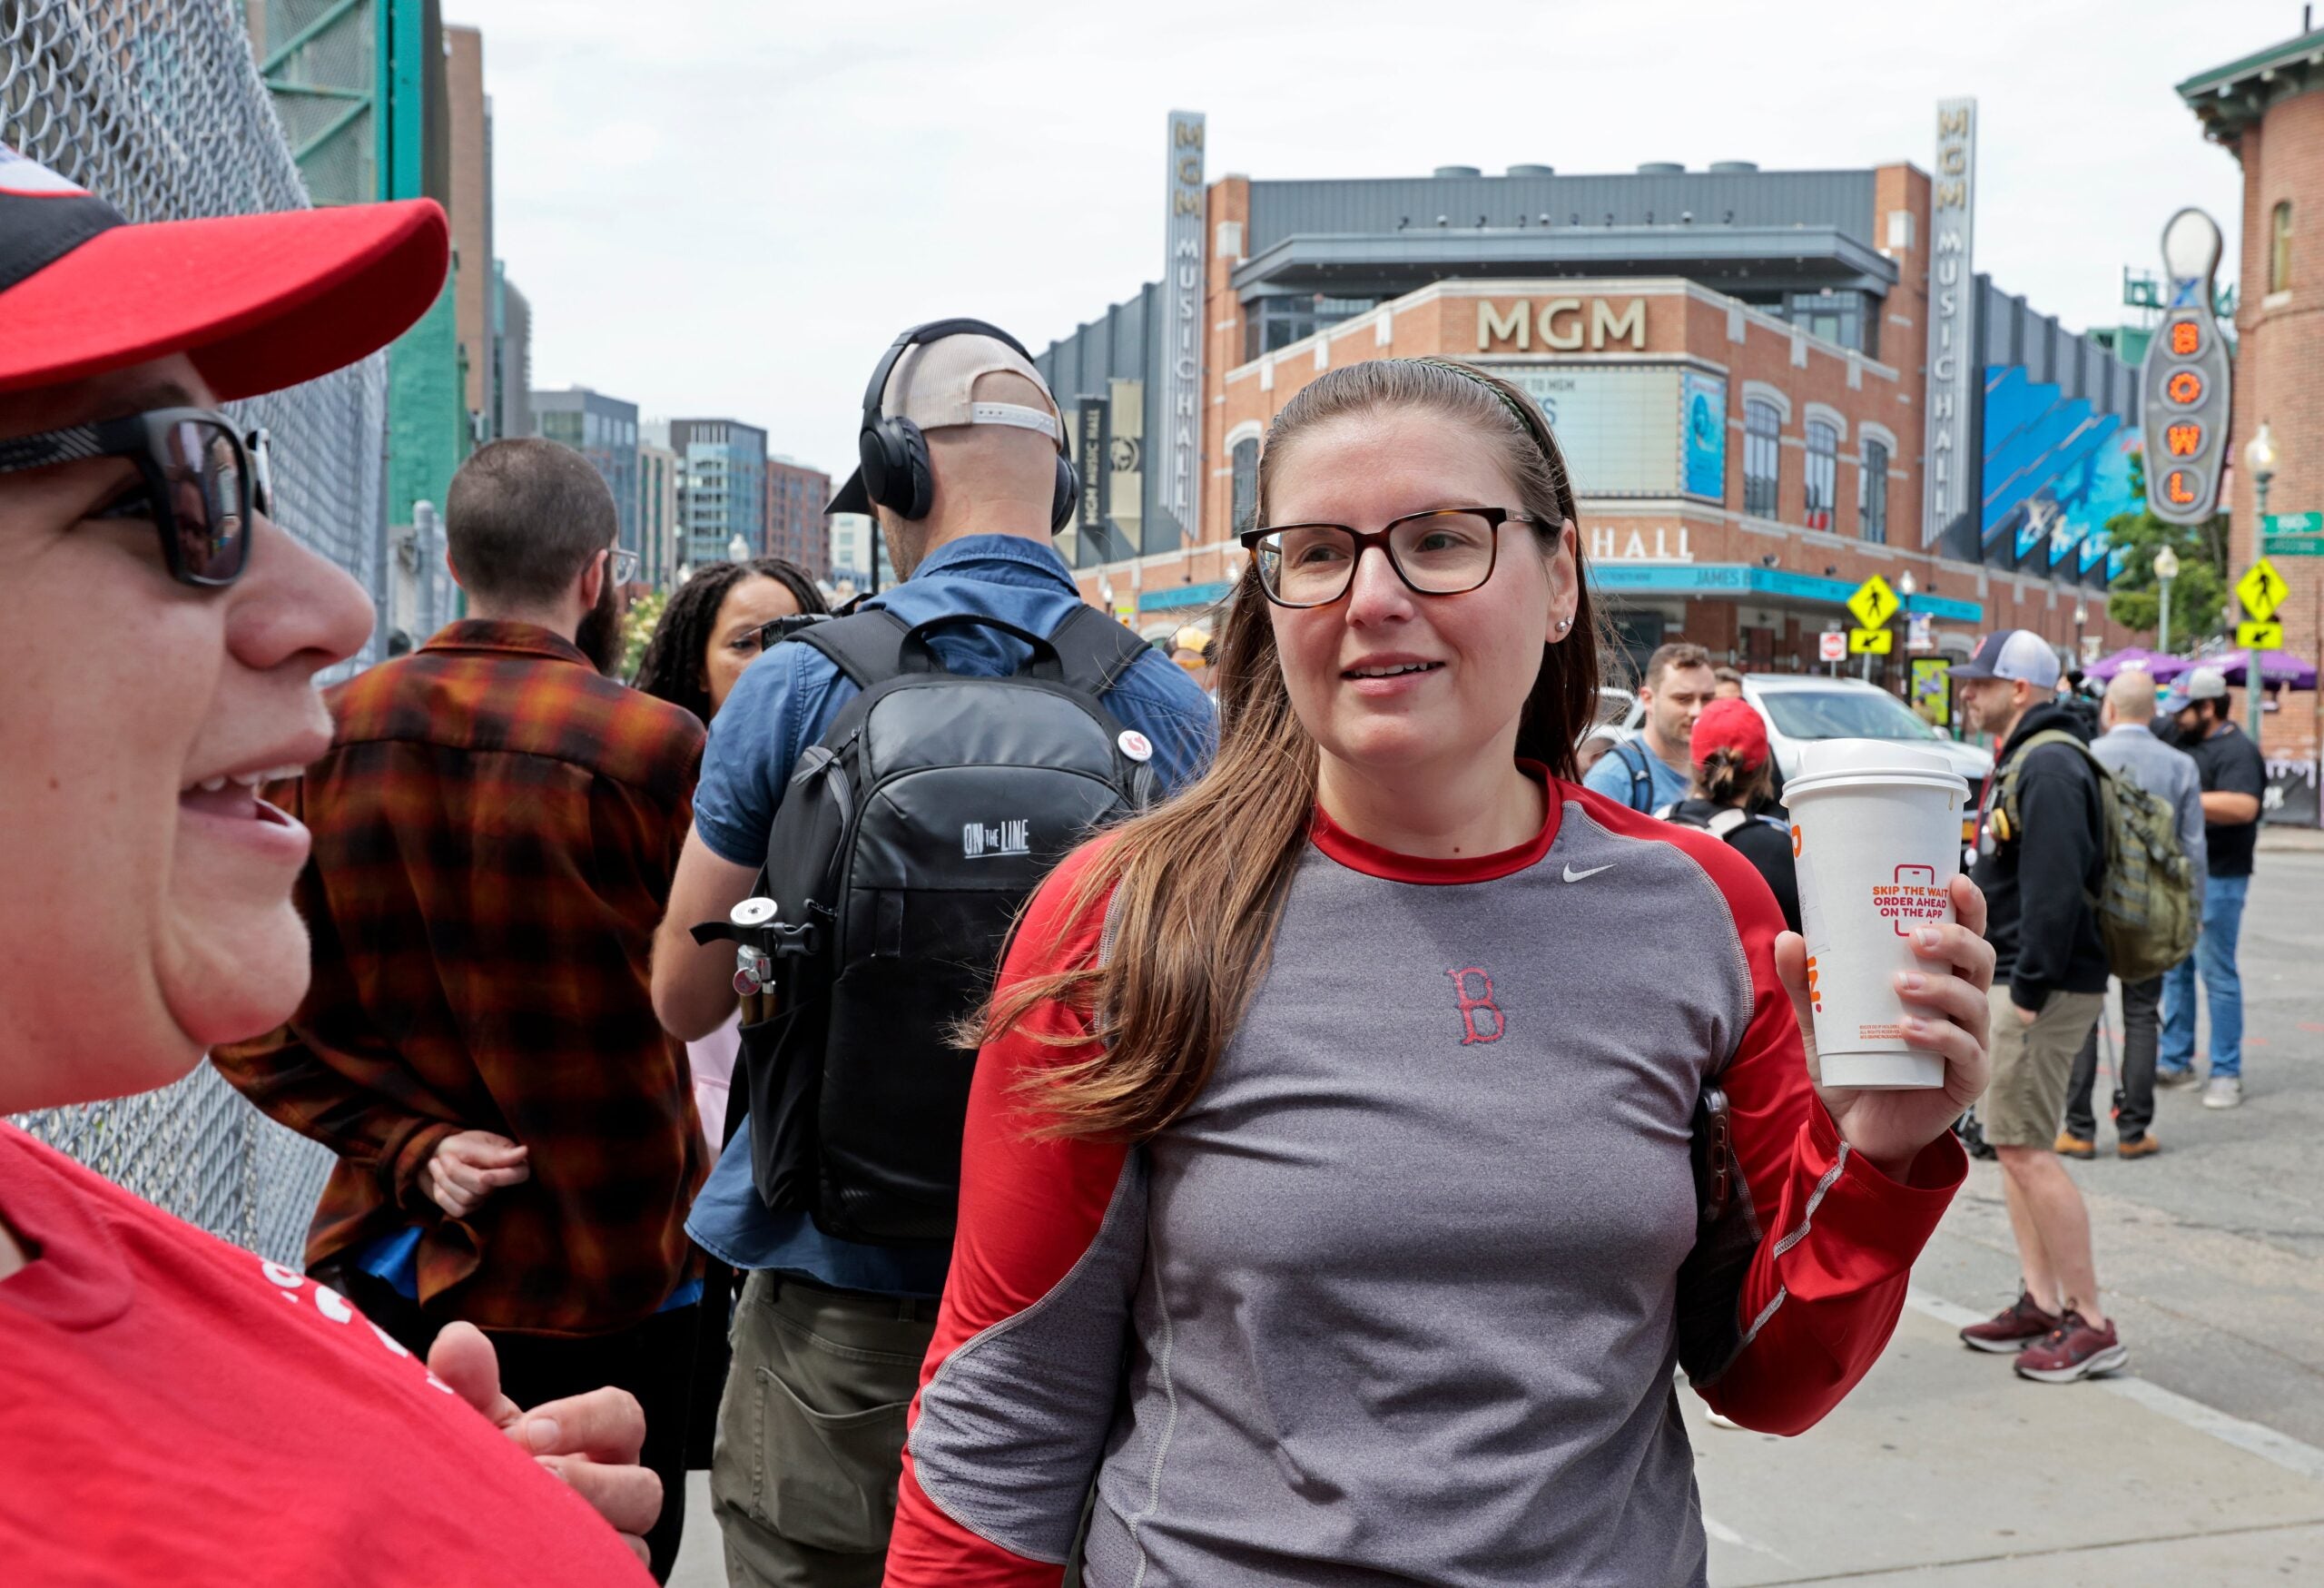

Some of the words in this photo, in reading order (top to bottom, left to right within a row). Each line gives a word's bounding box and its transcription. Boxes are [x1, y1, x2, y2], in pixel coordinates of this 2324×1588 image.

[1175, 121, 1204, 219] MGM
[1936, 107, 1969, 213] MGM
[1175, 238, 1199, 380] MUSIC
[1477, 297, 1647, 350] MGM
[1935, 228, 1963, 381] MUSIC
[2168, 322, 2201, 503] BOWL
[1086, 441, 1099, 486] MUSIC
[1175, 392, 1195, 509] HALL
[1935, 391, 1953, 515] HALL
[1085, 488, 1098, 525] MGM
[1591, 527, 1695, 558] HALL
[1695, 567, 1739, 587] JAMES
[963, 823, 984, 854] ON
[985, 828, 1000, 848] THE
[1000, 819, 1029, 852] LINE
[1873, 886, 1900, 896] SKIP
[1903, 886, 1925, 896] THE
[1927, 887, 1948, 898] WAIT
[1874, 897, 1914, 906] ORDER
[1916, 898, 1947, 909] AHEAD
[1880, 908, 1899, 917] ON
[1902, 908, 1924, 917] THE
[1925, 909, 1943, 919] APP
[1443, 966, 1504, 1045] B
